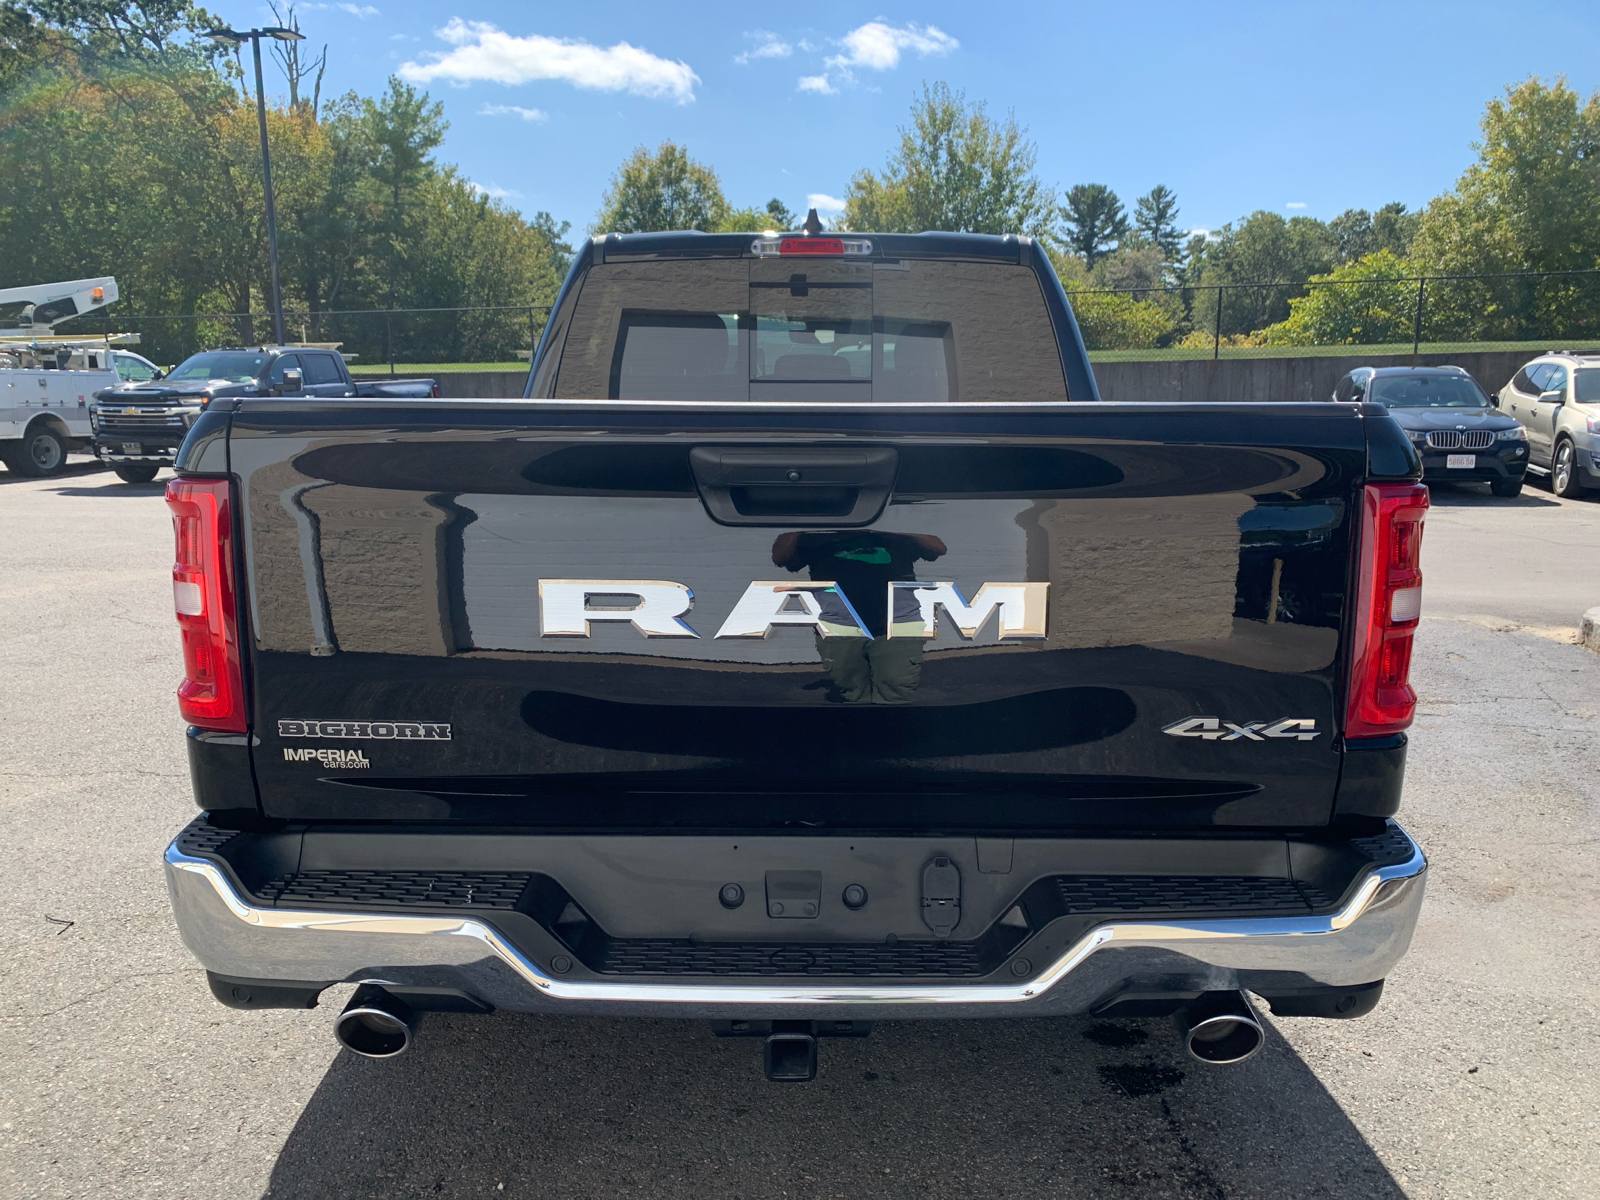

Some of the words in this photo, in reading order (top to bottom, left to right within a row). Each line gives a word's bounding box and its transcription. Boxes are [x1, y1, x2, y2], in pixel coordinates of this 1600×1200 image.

[537, 578, 1051, 640] RAM
[278, 720, 452, 740] BIGHORN
[1161, 716, 1321, 741] 4x4
[283, 748, 369, 762] IMPERIAL
[323, 760, 370, 769] cars.com
